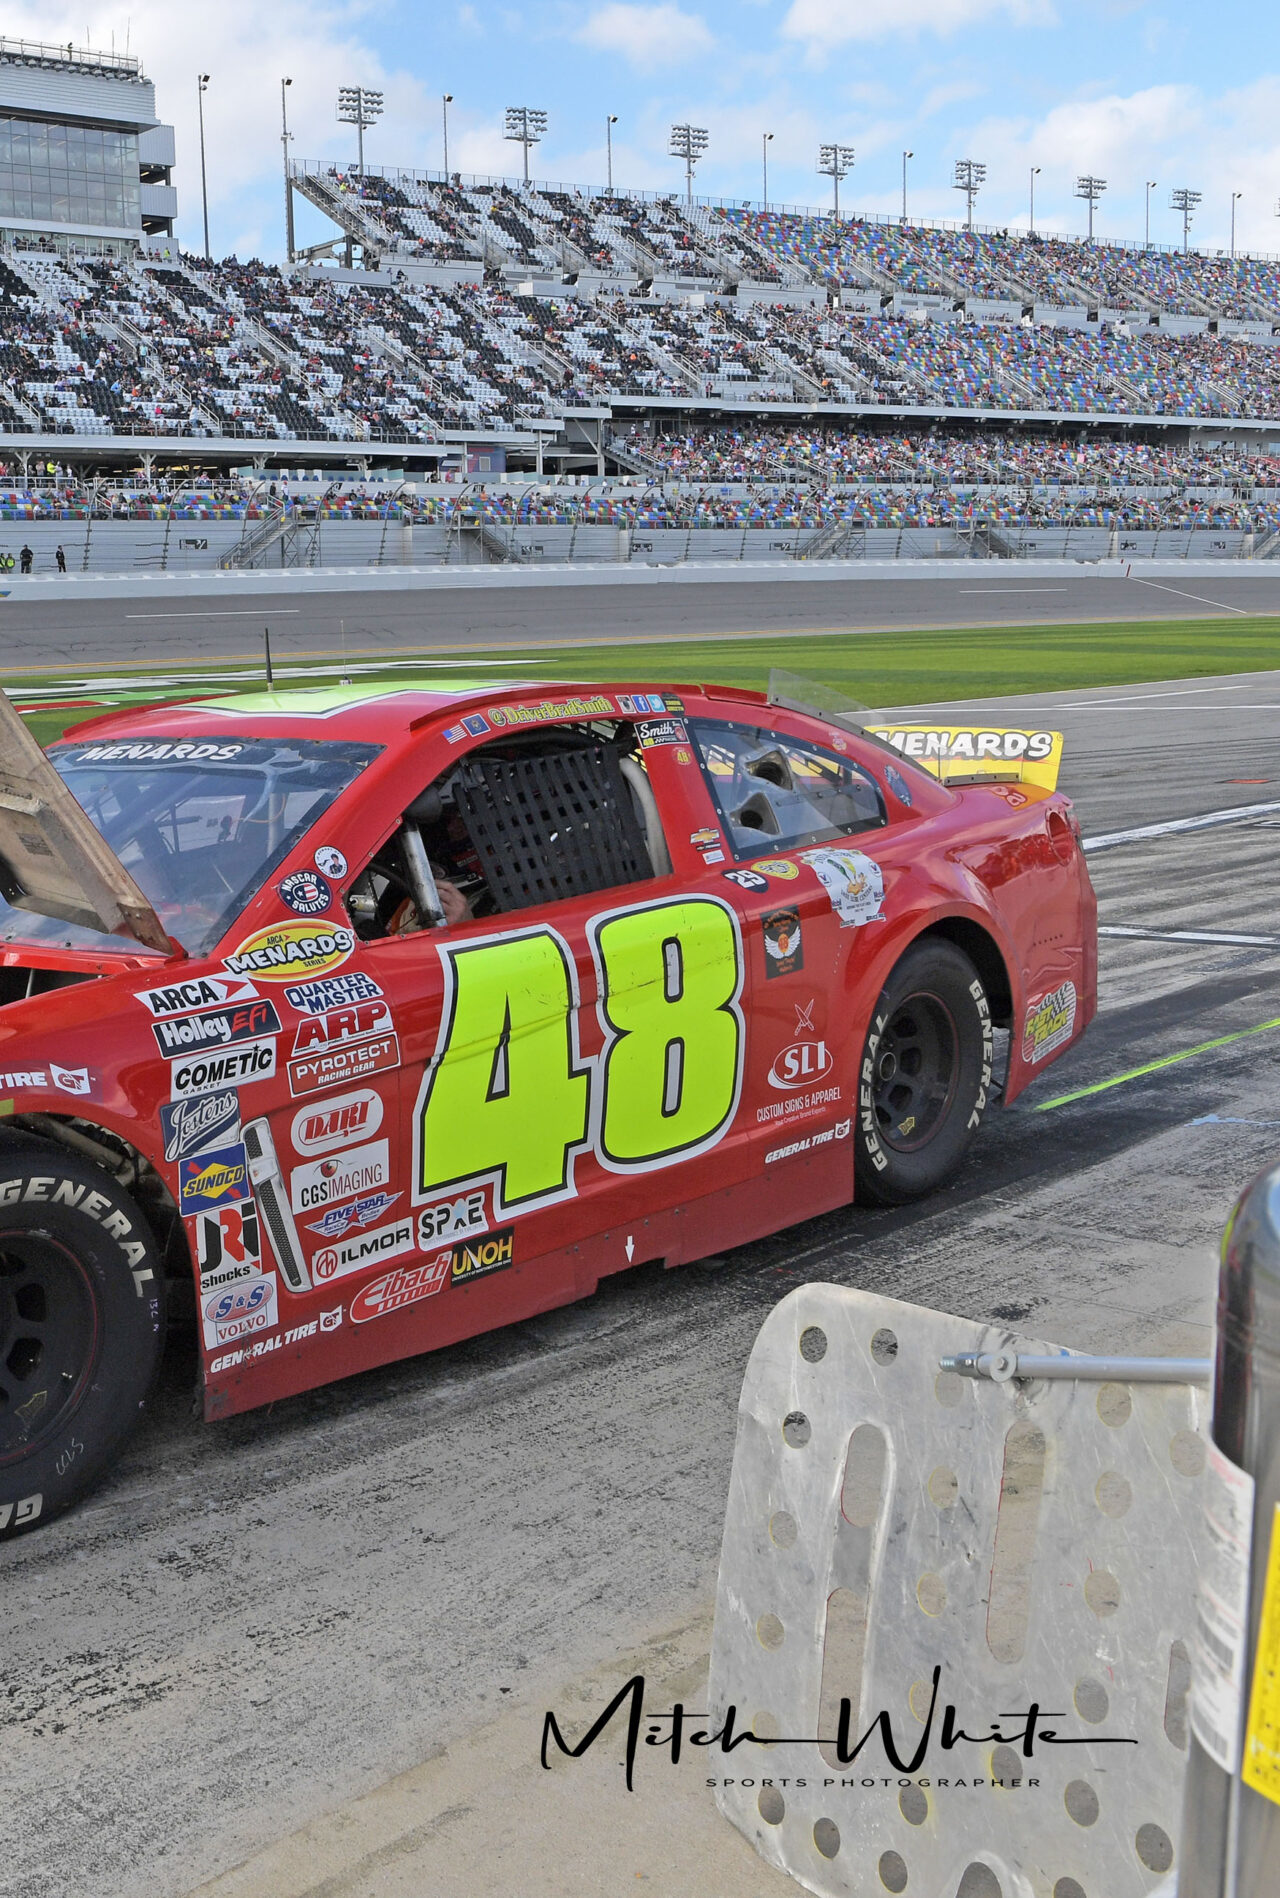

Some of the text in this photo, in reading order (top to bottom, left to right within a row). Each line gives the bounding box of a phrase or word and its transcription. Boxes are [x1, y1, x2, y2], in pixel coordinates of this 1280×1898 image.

[640, 721, 674, 739] Smith
[876, 731, 1053, 758] MENARDS
[75, 743, 243, 762] MENARDS
[281, 872, 318, 892] NASCAR
[724, 869, 766, 889] 29
[292, 893, 330, 913] SALUTES
[227, 931, 351, 974] MENARDS
[267, 934, 284, 946] ARCA
[303, 957, 327, 968] SERIES
[149, 980, 220, 1013] ARCA
[285, 973, 369, 1007] QUARTER
[306, 983, 380, 1014] MASTER
[160, 1015, 232, 1048] Holley
[295, 1002, 387, 1050] ARP
[175, 1046, 273, 1091] COMETIC
[296, 1041, 390, 1079] PYROTECT
[412, 893, 745, 1222] 48
[783, 1041, 825, 1079] SLI
[968, 979, 994, 1129] GENERAL
[183, 1081, 222, 1095] GASKET
[318, 1061, 375, 1084] RACING GEAR
[757, 1087, 841, 1122] CUSTOM SIGNS & APPAREL
[861, 1013, 889, 1171] GENERAL
[166, 1092, 238, 1162] Jostens
[765, 1138, 811, 1164] GENERAL
[811, 1130, 835, 1147] TIRE
[187, 1166, 243, 1195] SUNOCO
[324, 1193, 386, 1226] FIVE STAR
[341, 1227, 410, 1264] ILMOR
[452, 1236, 513, 1275] UNOH
[202, 1266, 251, 1289] shocks
[357, 1255, 448, 1312] Eibach
[218, 1314, 266, 1340] VOLVO
[284, 1320, 318, 1344] TIRE
